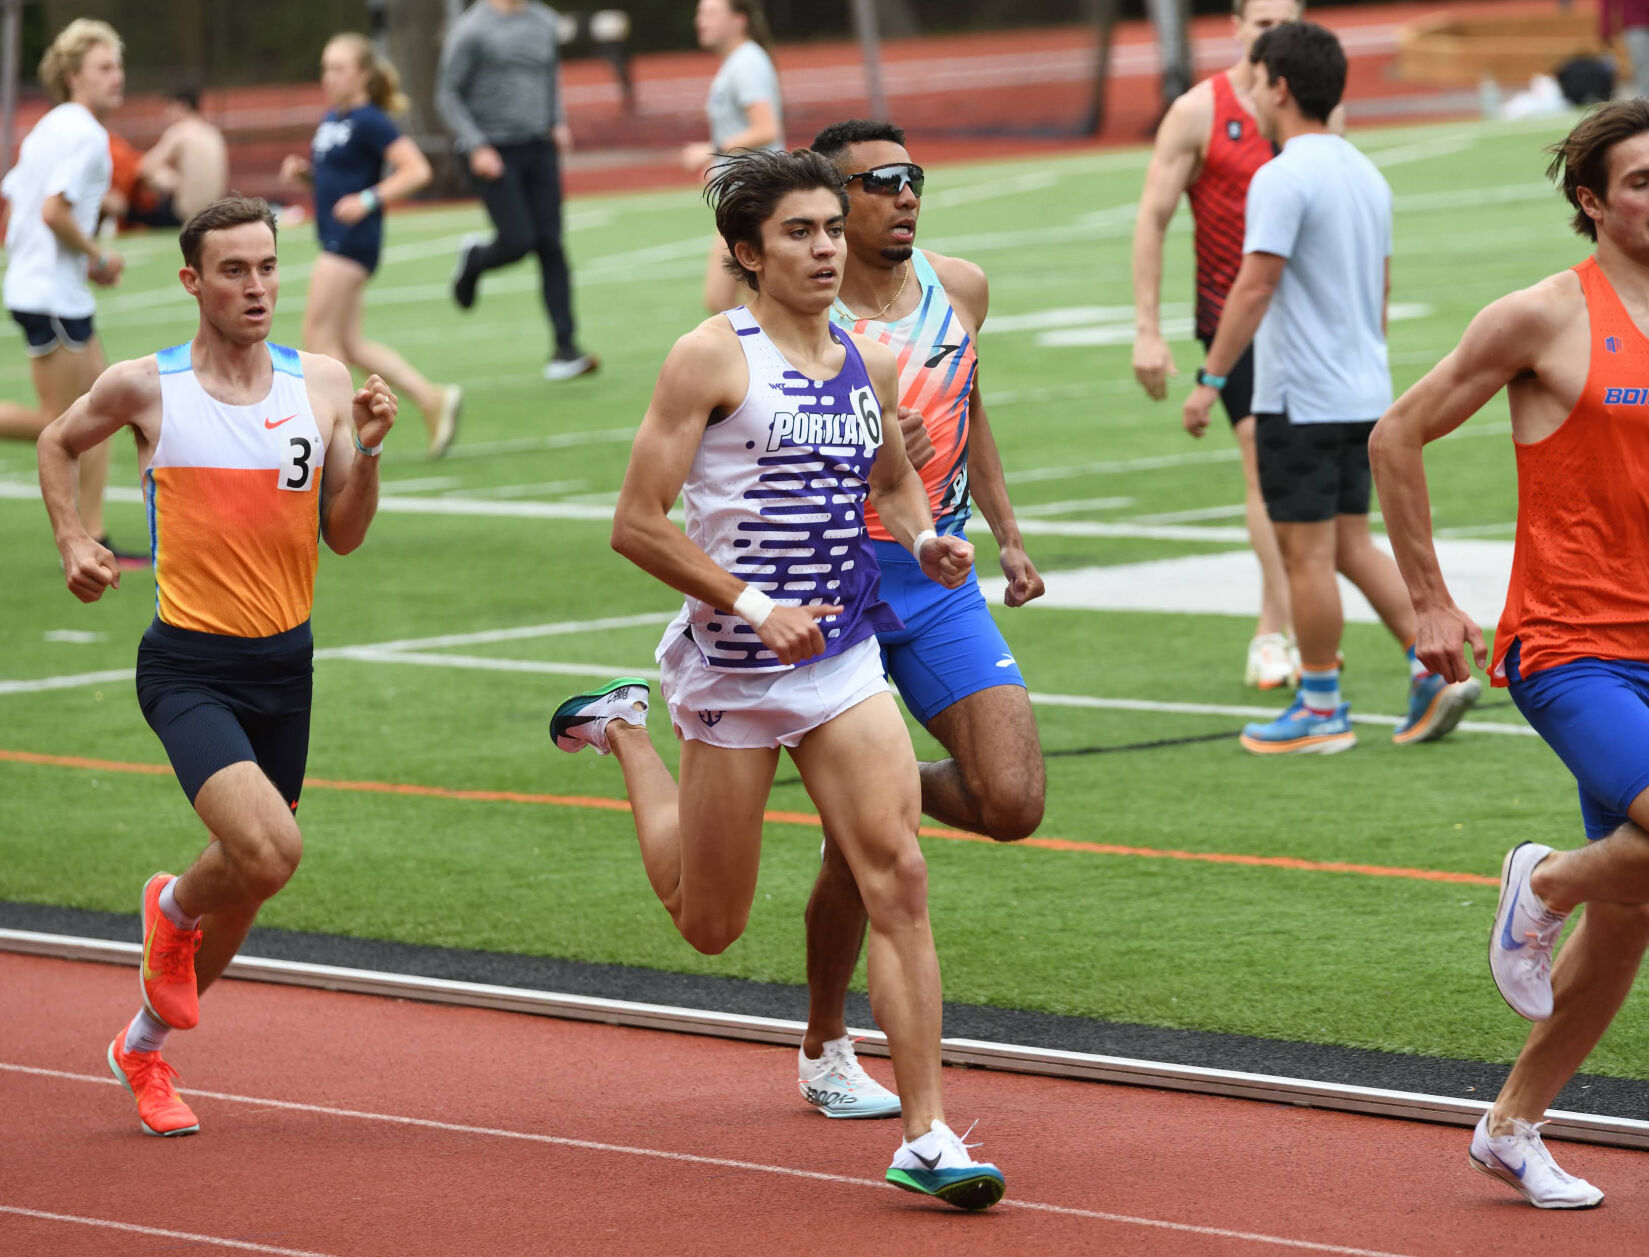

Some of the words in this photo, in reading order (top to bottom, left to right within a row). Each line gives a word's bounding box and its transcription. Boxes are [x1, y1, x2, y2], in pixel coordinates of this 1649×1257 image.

[859, 391, 880, 444] 6
[1603, 388, 1649, 405] BOI
[766, 411, 866, 453] PORTLA
[286, 437, 311, 489] 3
